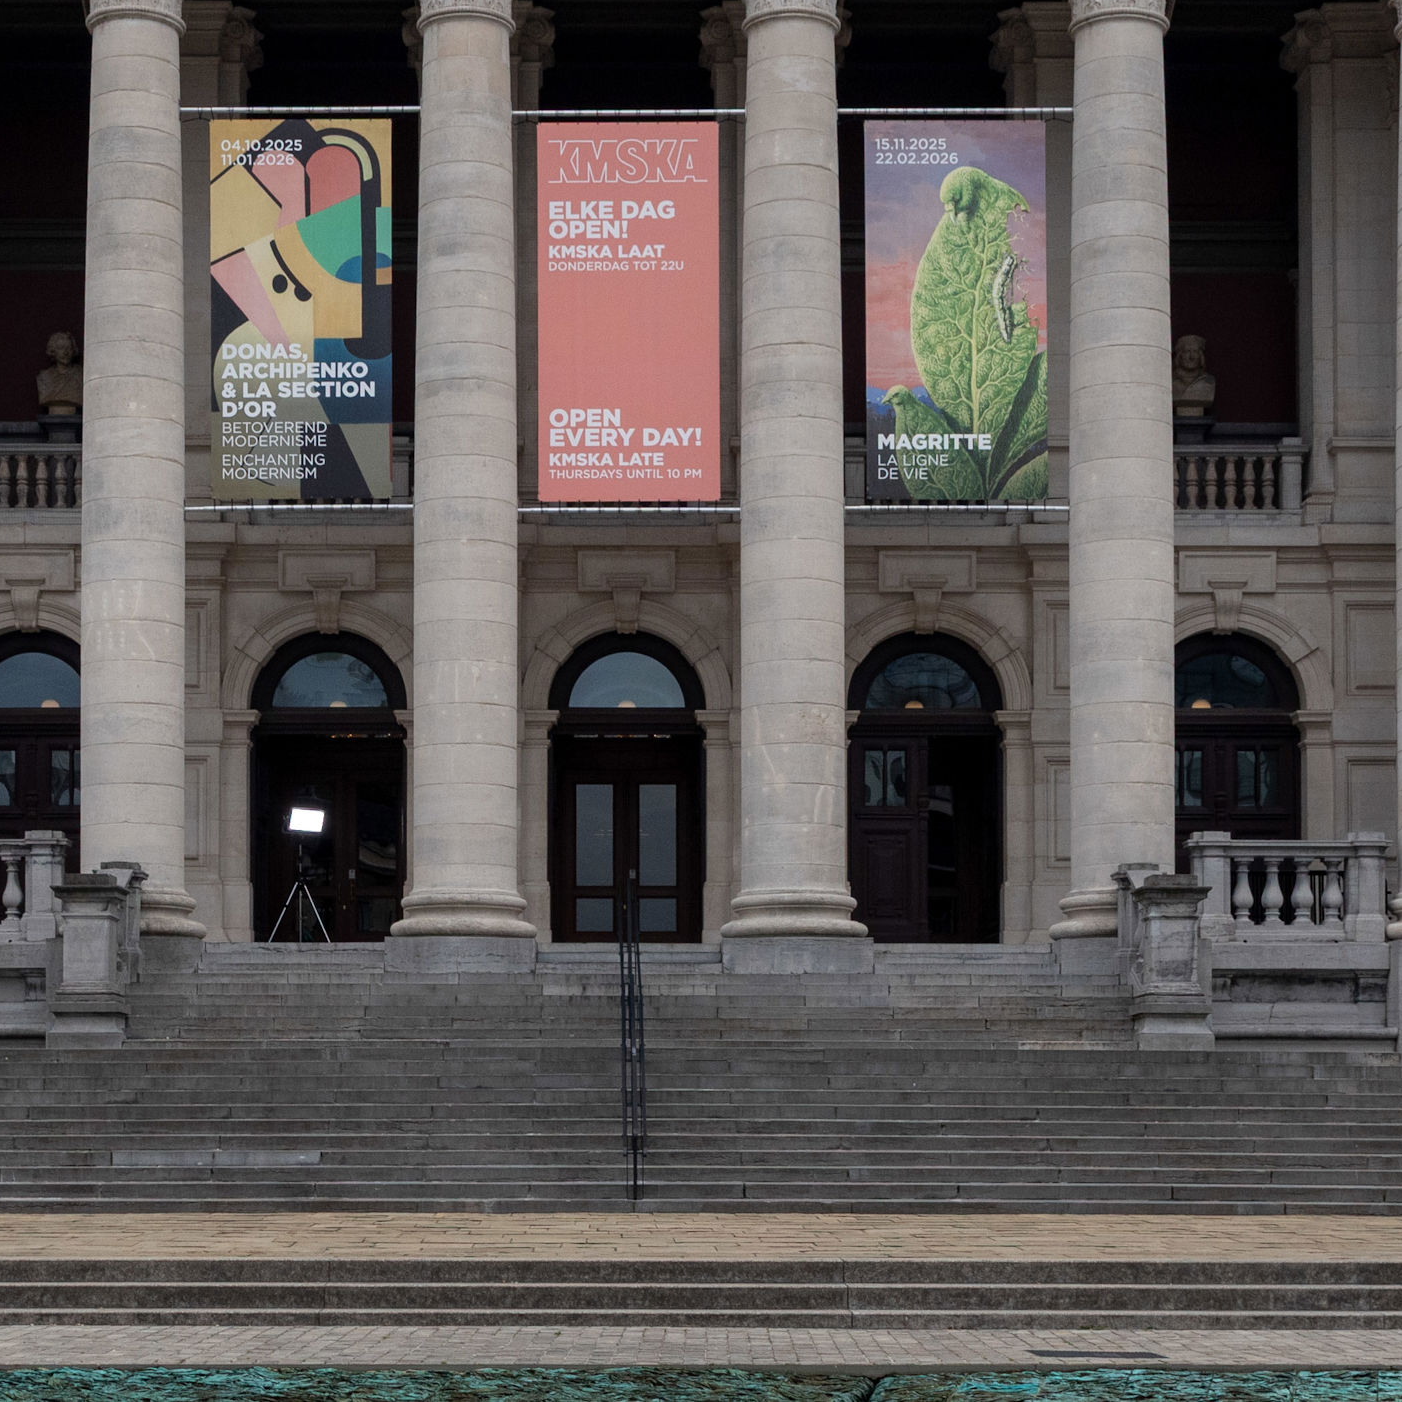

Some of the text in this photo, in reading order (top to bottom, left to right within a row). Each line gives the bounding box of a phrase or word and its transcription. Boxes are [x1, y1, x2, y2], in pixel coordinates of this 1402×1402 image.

[220, 139, 303, 152] 04.10.2025
[875, 138, 948, 150] 15.11.2025
[220, 153, 295, 166] 11.01.2026
[548, 138, 708, 184] KMSKA
[875, 152, 959, 165] 22.02.2026
[548, 200, 676, 220] ELKE DAG
[548, 219, 628, 239] OPEN!
[548, 244, 665, 259] KMSKA LAAT
[548, 260, 685, 272] DONDERDAG TOT 22U
[221, 343, 308, 362] DONAS,
[221, 362, 369, 380] ARCHIPENKO
[221, 381, 376, 399] & LA SECTION
[221, 401, 277, 418] D'OR
[549, 408, 621, 428] OPEN
[222, 421, 328, 434] BETOVEREND
[222, 435, 327, 447] MODERNISME
[549, 427, 702, 447] EVERY DAY!
[877, 433, 992, 451] MAGRITTE
[222, 453, 326, 467] ENCHANTING
[549, 452, 665, 467] KMSKA LATE
[877, 454, 949, 467] LA LIGNE
[222, 467, 317, 480] MODERNISM
[549, 468, 703, 479] THURSDAYS UNTIL 10 PM
[877, 468, 929, 480] DE VIE
